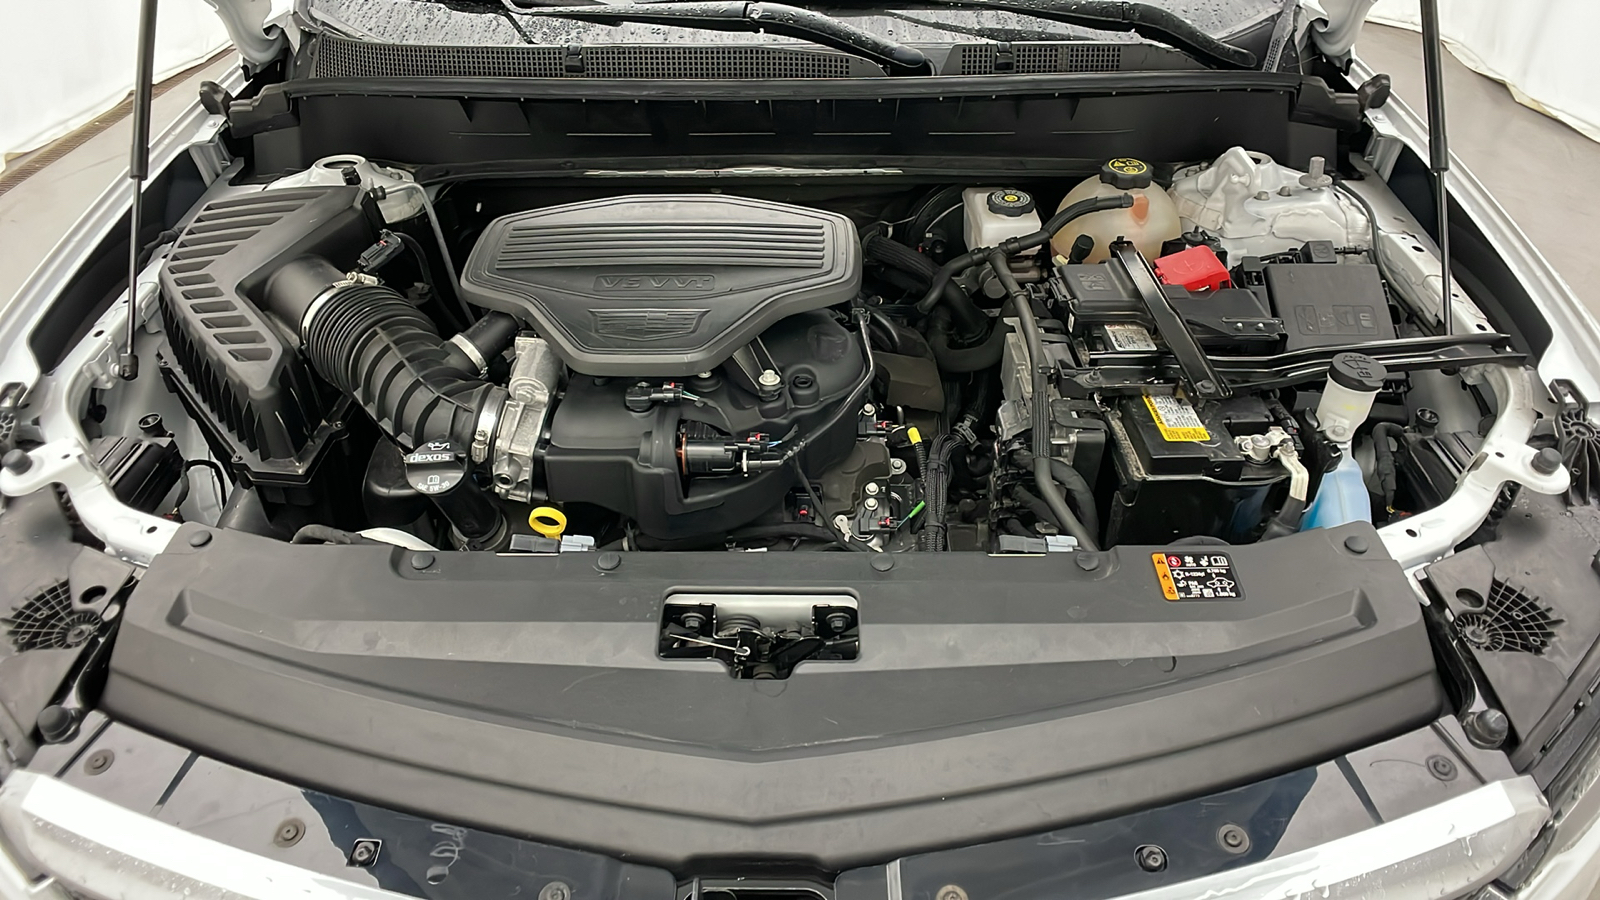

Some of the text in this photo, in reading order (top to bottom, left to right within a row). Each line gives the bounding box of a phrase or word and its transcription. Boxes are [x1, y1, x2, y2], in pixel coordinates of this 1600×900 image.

[649, 277, 712, 288] VVT
[410, 453, 451, 462] dexos
[429, 480, 450, 492] 5W-30
